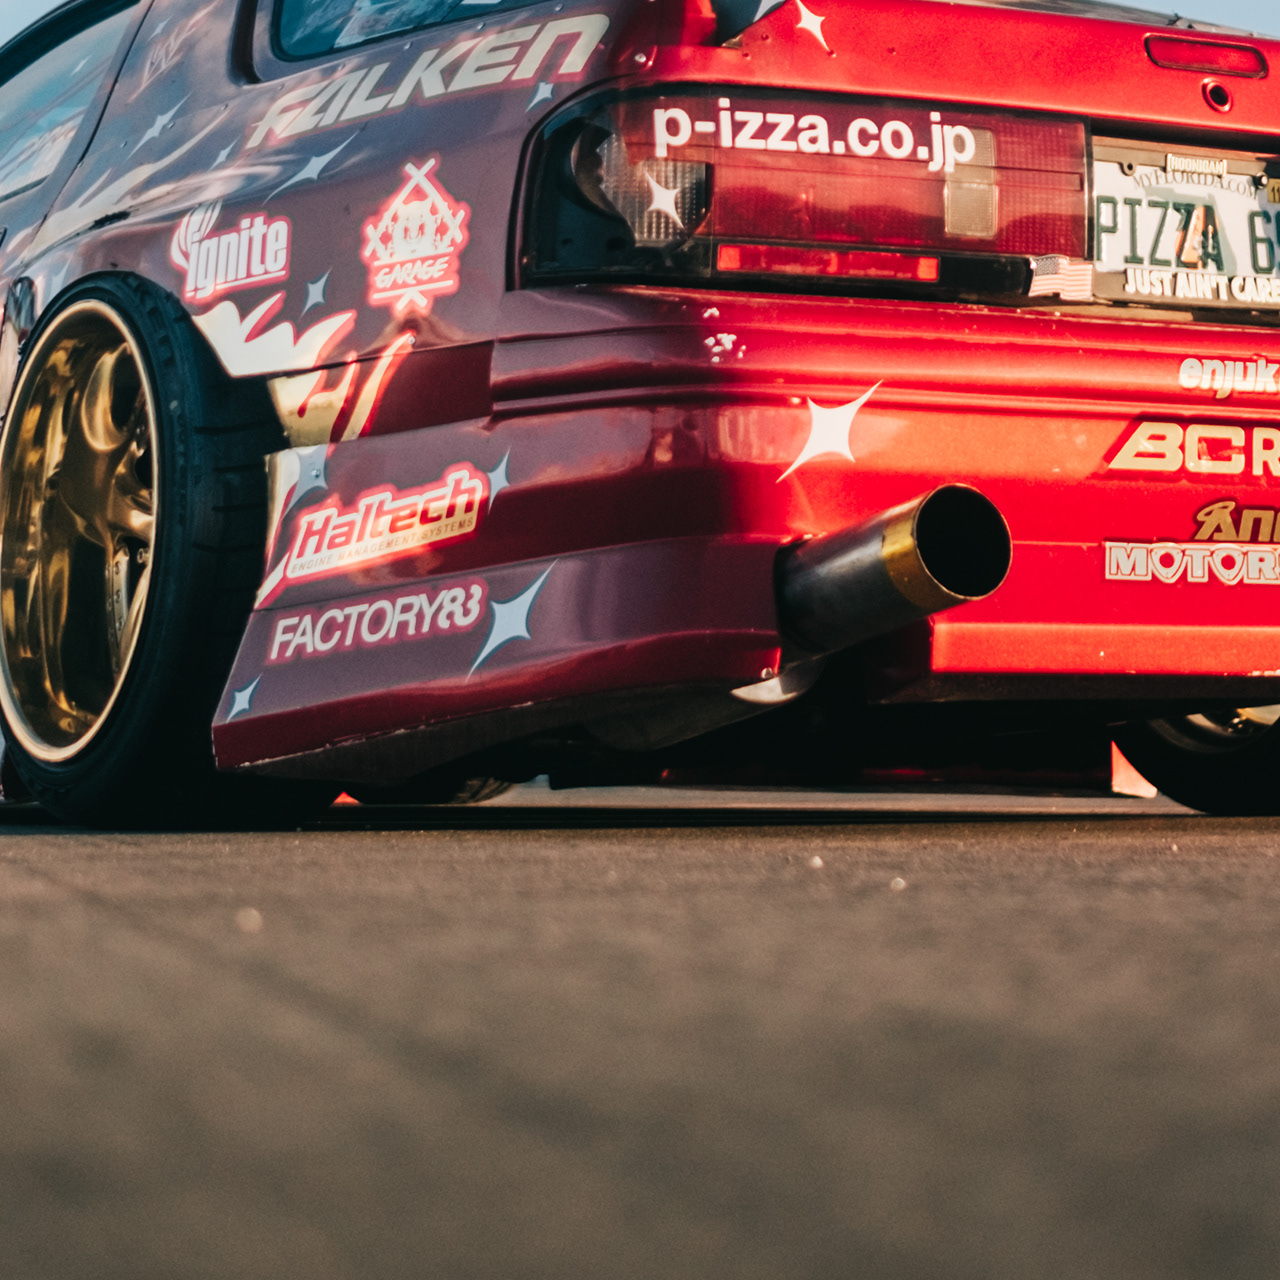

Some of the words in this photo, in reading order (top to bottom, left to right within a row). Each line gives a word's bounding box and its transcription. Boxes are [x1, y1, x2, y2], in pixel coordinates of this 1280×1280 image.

[245, 14, 610, 150] FALKEN
[653, 98, 976, 172] p-izza.co.jp
[1096, 195, 1225, 271] PIZZA
[374, 256, 450, 288] GARAGE
[1125, 269, 1173, 296] JUST
[1175, 272, 1229, 301] AIN'T
[291, 553, 335, 575] ENGINE
[337, 532, 417, 562] MANAGEMENT
[421, 517, 474, 541] SYSTEMS
[294, 470, 483, 561] Haltech
